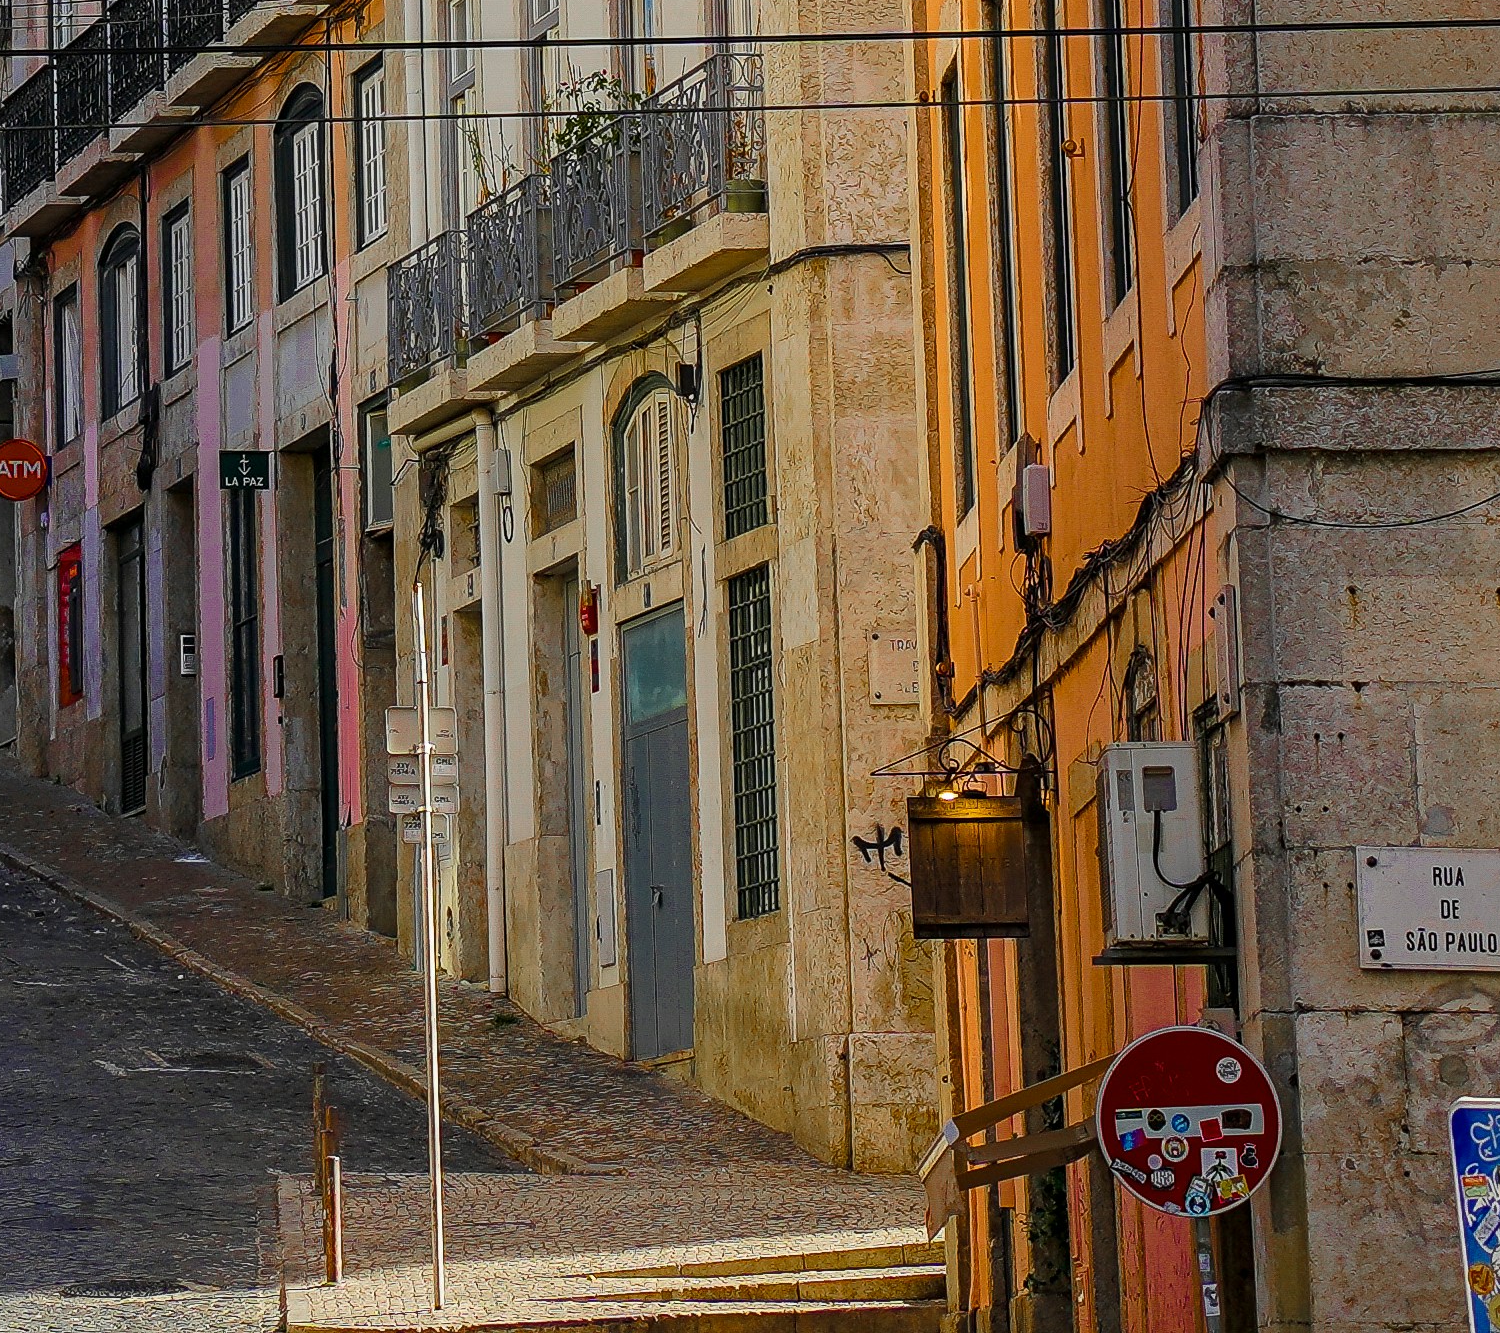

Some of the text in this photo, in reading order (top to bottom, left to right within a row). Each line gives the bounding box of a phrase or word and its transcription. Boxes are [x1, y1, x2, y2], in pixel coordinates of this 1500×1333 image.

[225, 507, 265, 517] LA PAZ
[1432, 866, 1465, 886] RUA
[1440, 899, 1460, 919] DE
[1406, 927, 1498, 953] SÃO PAULO
